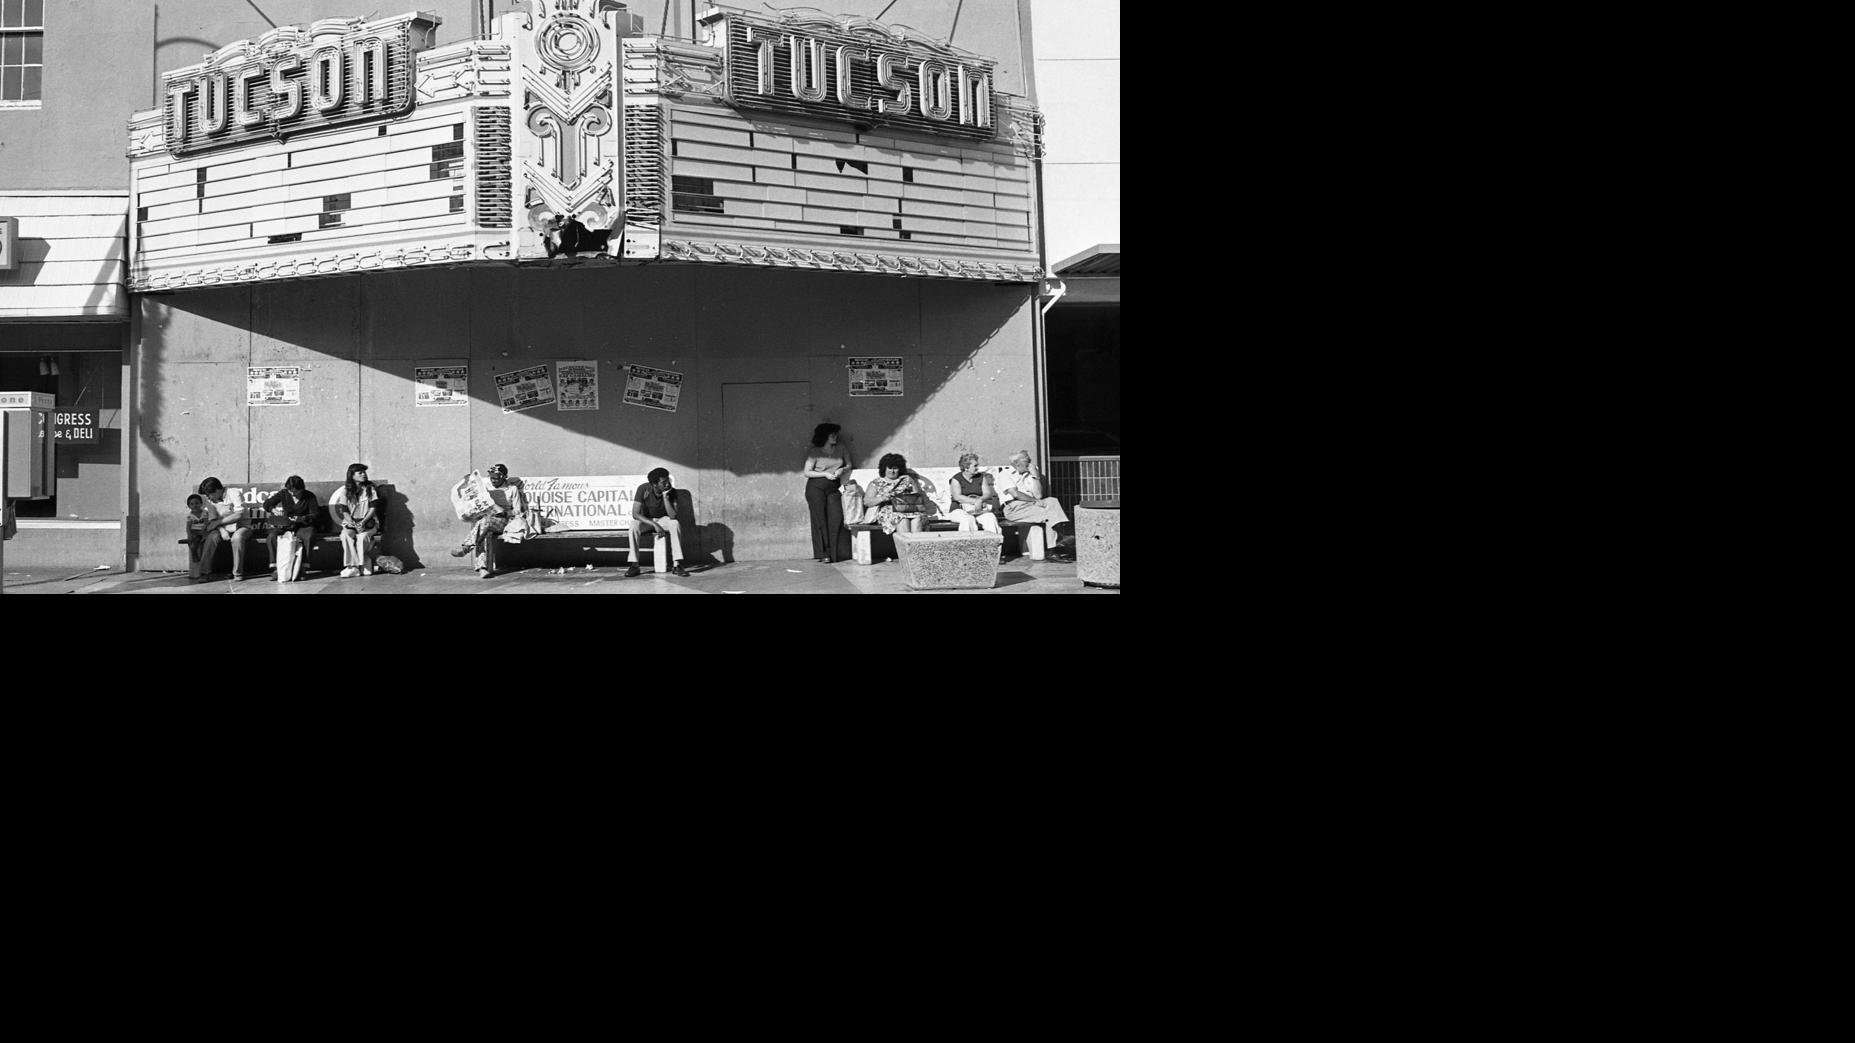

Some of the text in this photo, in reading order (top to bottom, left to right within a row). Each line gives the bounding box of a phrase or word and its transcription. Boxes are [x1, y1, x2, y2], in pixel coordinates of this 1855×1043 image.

[747, 27, 991, 128] TUCSON
[166, 36, 388, 142] TUCSON
[38, 412, 92, 425] GRESS
[73, 428, 93, 439] DELI
[524, 480, 547, 491] orld
[577, 490, 635, 503] CAPITAL
